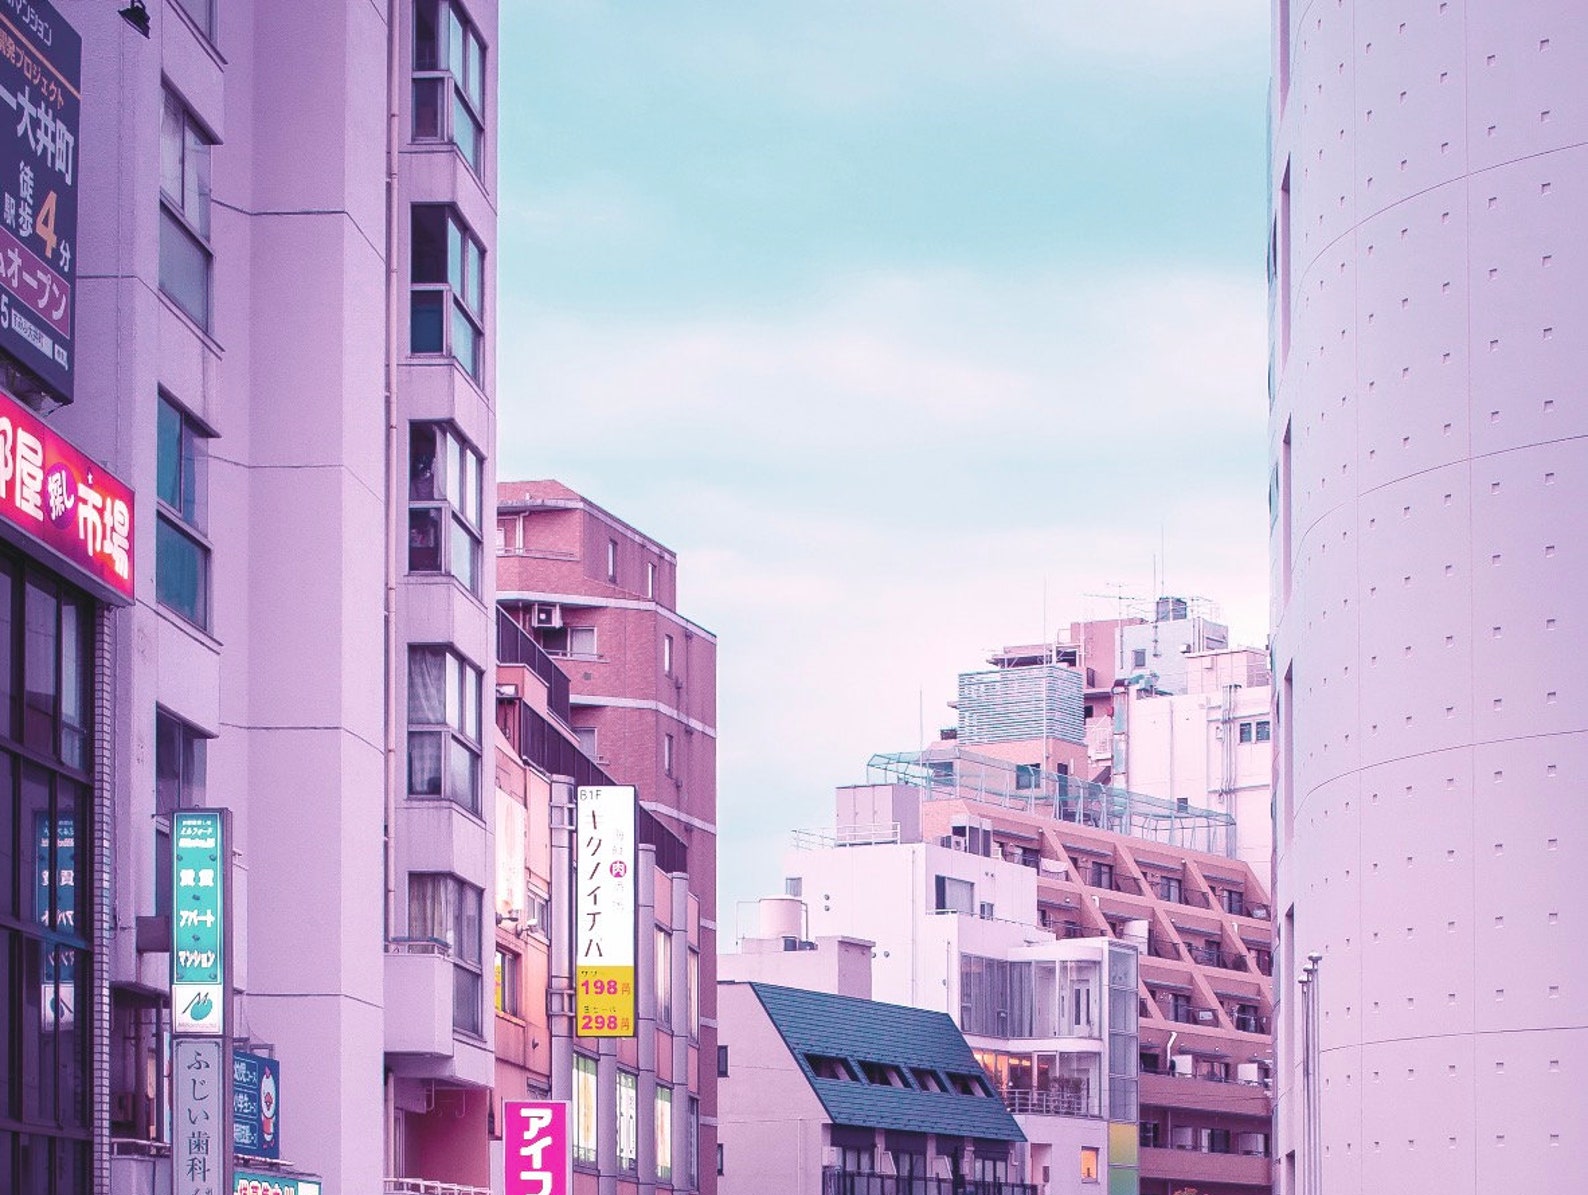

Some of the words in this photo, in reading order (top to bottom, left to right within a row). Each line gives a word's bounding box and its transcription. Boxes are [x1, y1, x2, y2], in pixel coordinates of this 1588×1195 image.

[186, 1052, 212, 1183] ふじい歯科
